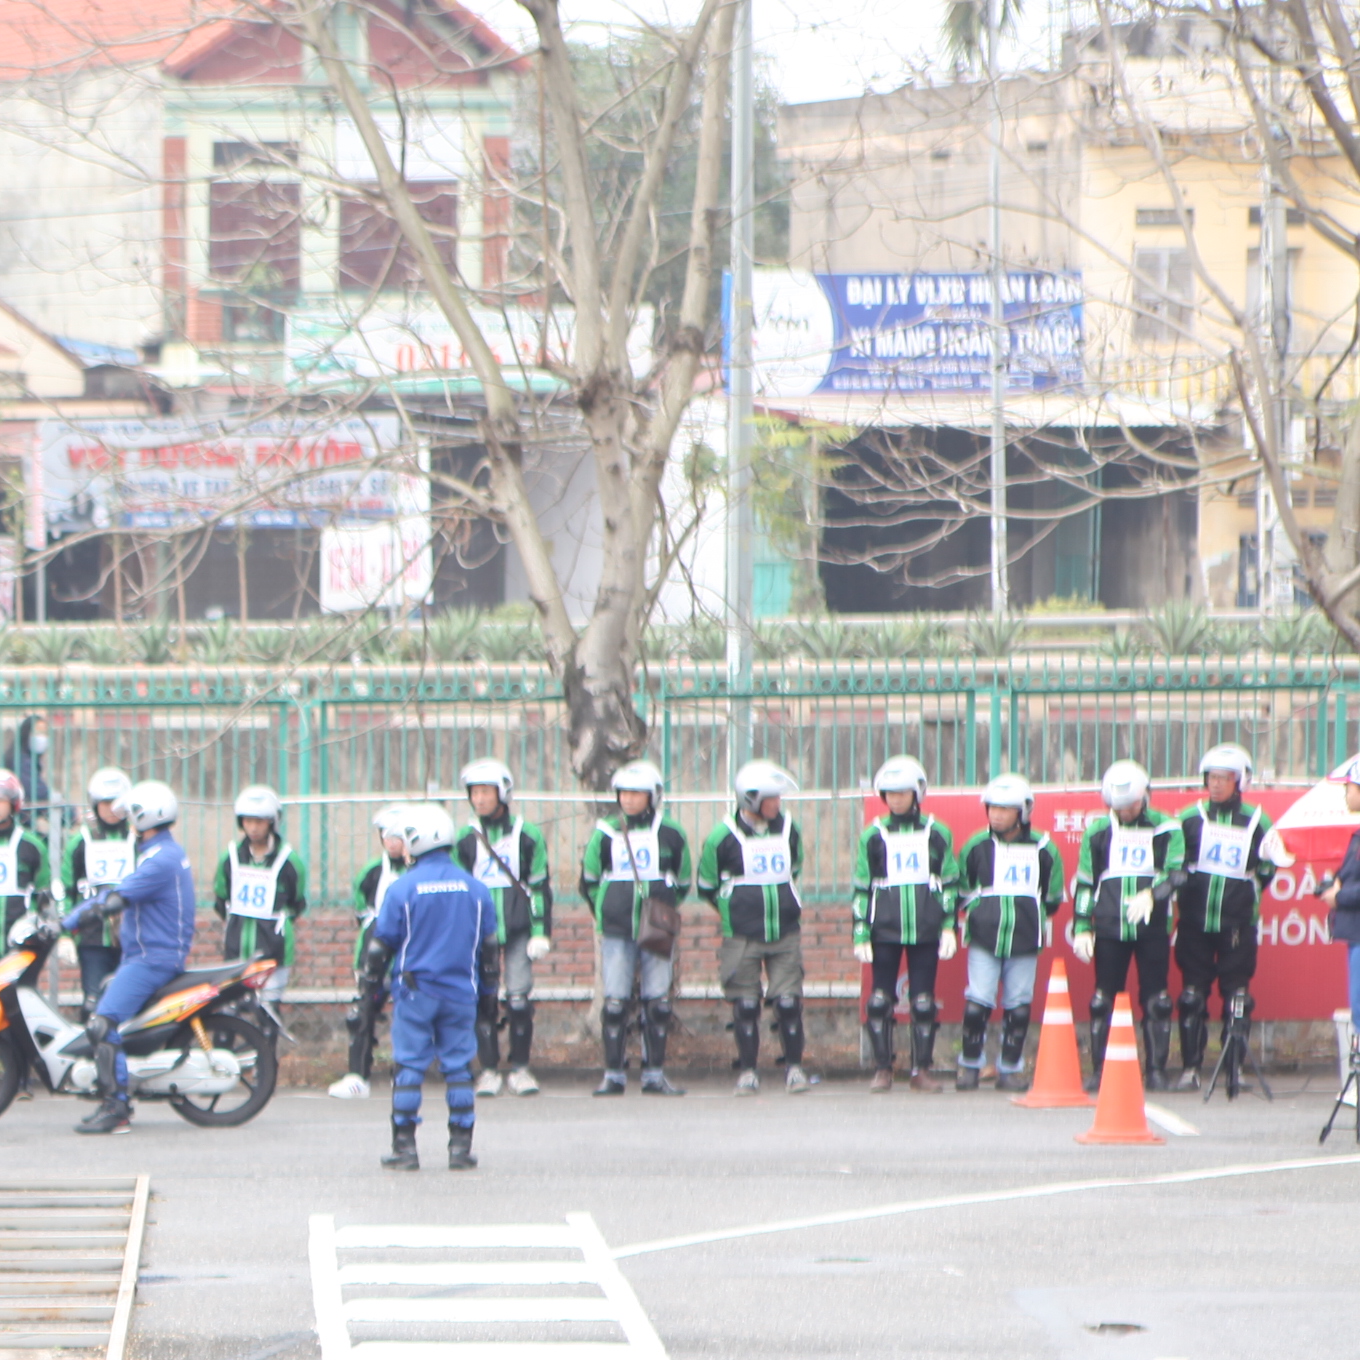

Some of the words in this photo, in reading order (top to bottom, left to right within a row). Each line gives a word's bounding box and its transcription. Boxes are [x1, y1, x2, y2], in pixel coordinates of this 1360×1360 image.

[619, 848, 651, 871] 29
[752, 853, 785, 875] 36
[892, 851, 920, 873] 14
[1118, 846, 1146, 867] 19
[1206, 843, 1243, 868] 43
[93, 859, 127, 878] 37
[237, 884, 267, 908] 48
[416, 880, 469, 895] HONDA
